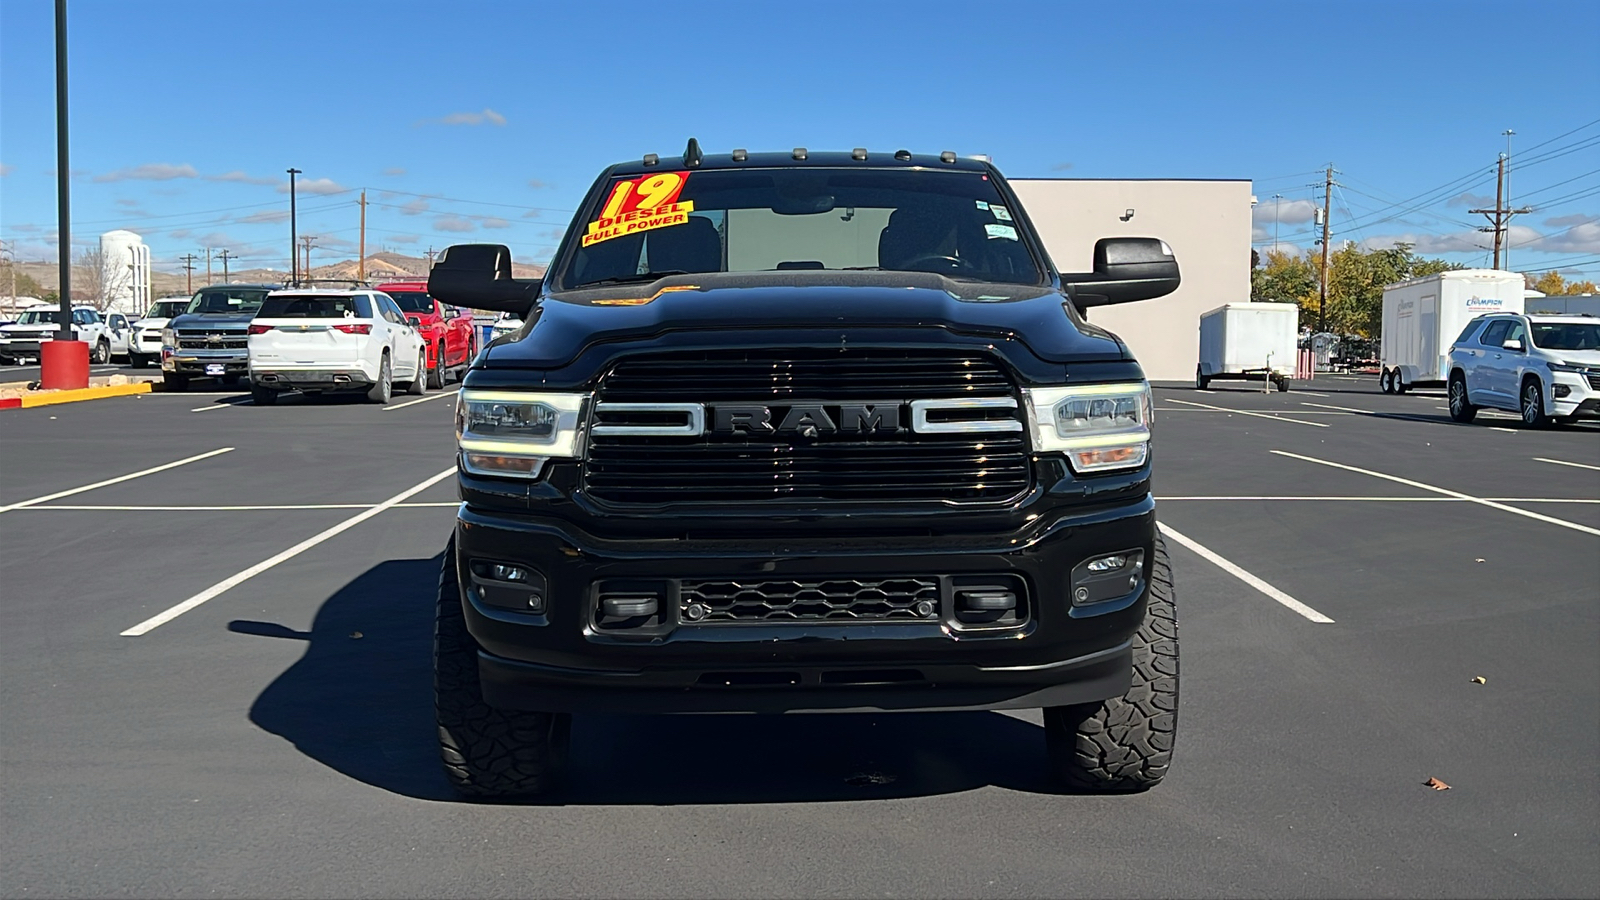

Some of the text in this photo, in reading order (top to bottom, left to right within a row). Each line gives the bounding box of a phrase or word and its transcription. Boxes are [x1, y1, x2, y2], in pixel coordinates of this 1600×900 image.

[602, 173, 682, 219] 19
[584, 214, 684, 244] FULL POWER
[598, 204, 685, 229] DIESEL
[714, 404, 900, 432] RAM
